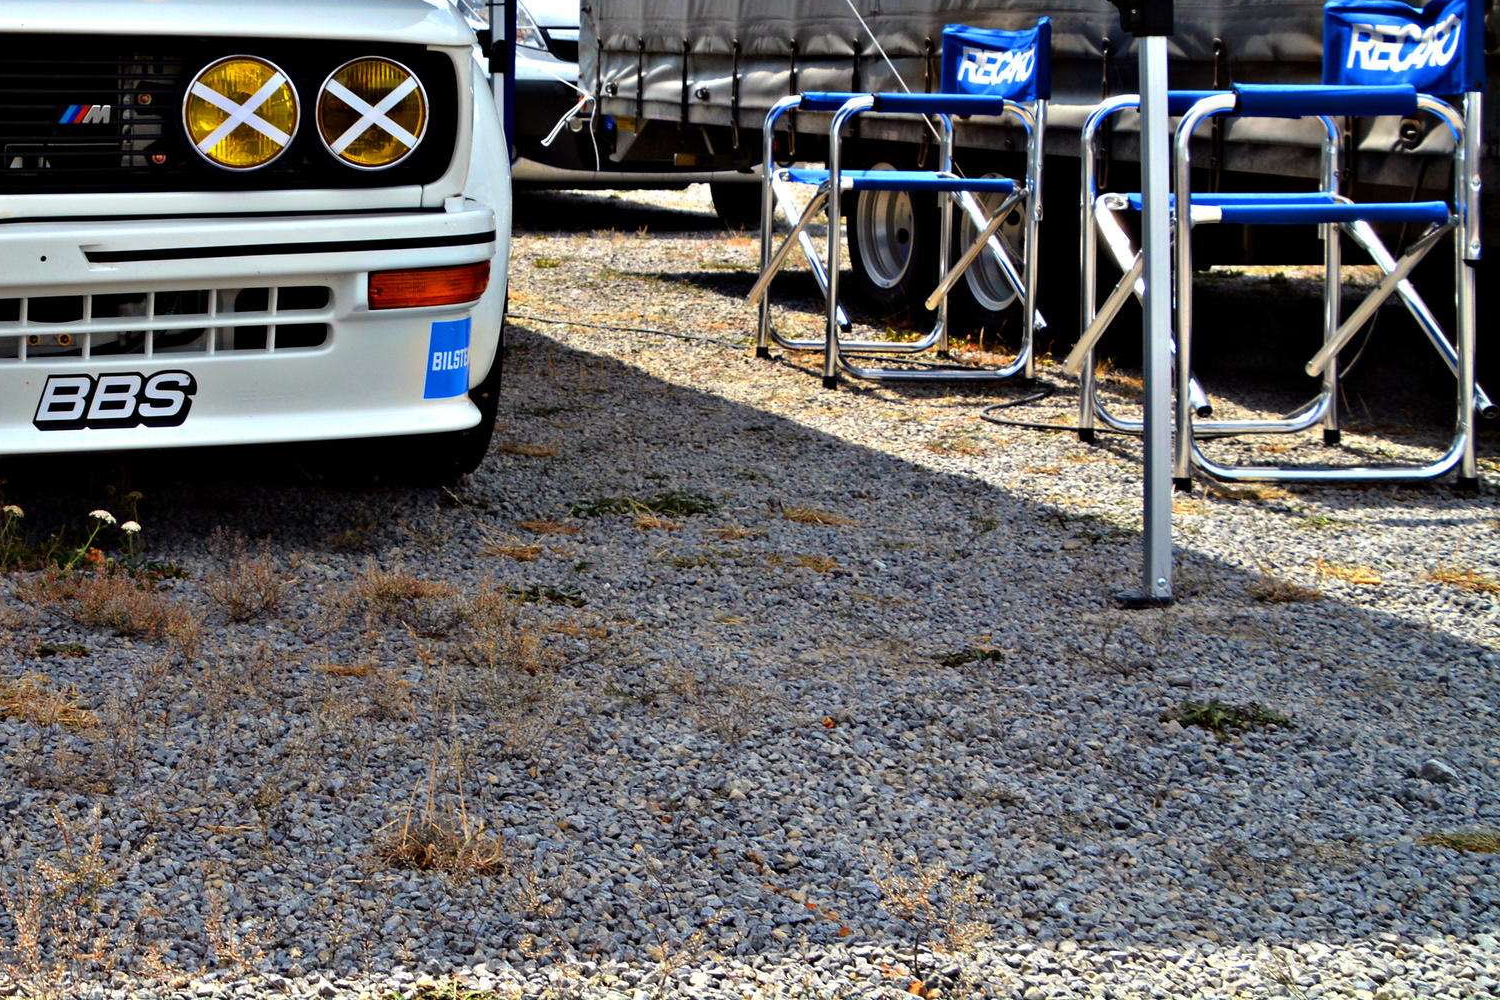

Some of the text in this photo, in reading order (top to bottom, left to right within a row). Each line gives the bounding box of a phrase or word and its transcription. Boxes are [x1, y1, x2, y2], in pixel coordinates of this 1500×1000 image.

[957, 43, 1035, 85] RECARO
[1346, 13, 1461, 72] RECARO
[34, 369, 197, 431] BBS
